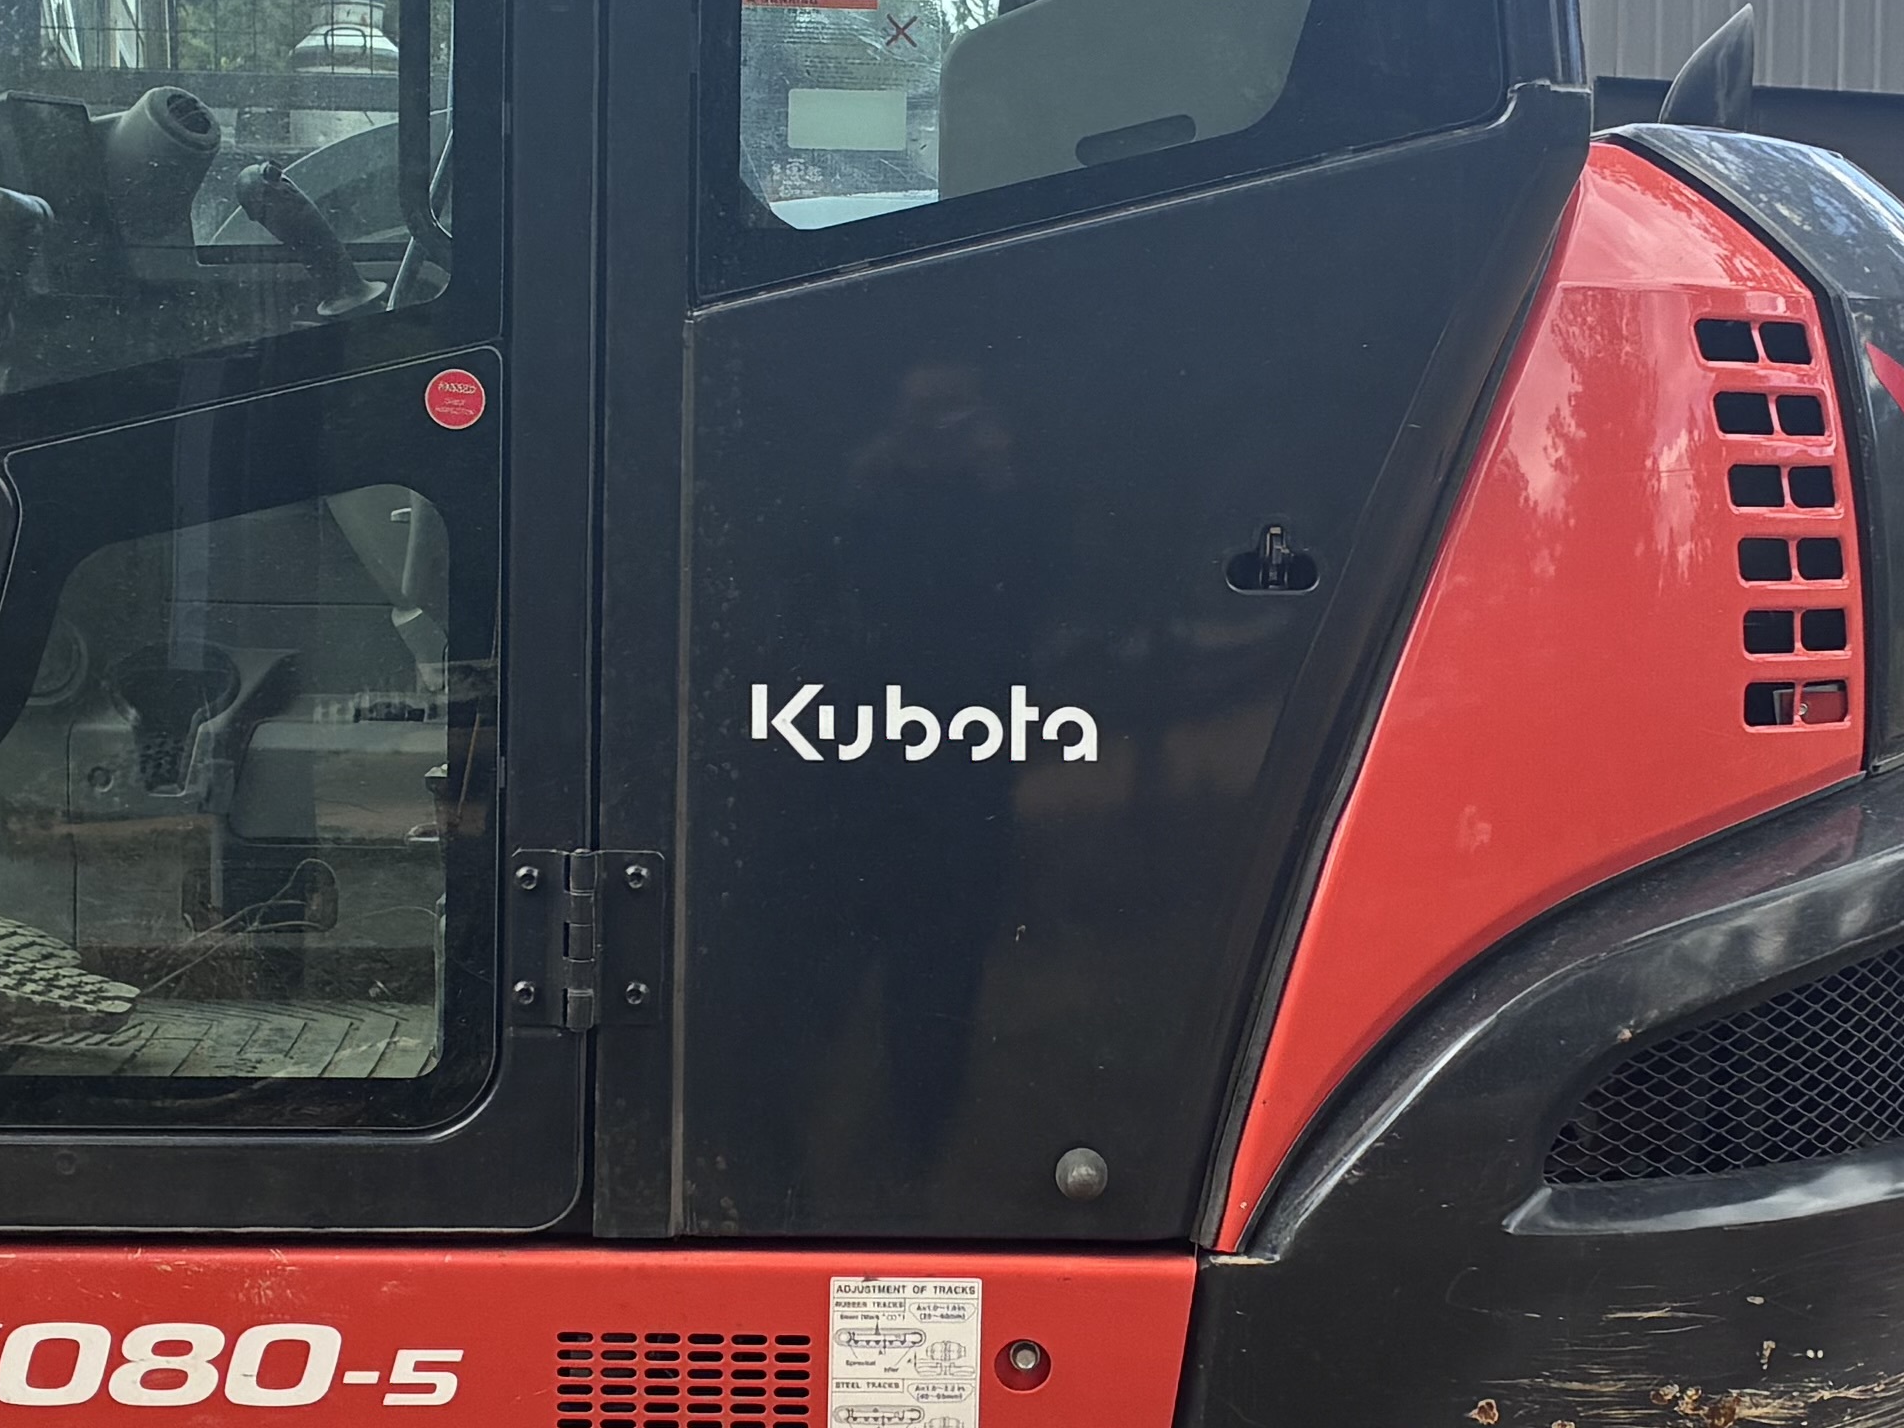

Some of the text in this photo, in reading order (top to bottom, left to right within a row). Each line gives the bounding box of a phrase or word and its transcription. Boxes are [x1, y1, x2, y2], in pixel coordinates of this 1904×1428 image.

[751, 683, 1098, 762] Kubota
[836, 1284, 976, 1295] ADJUSTMENT OF TRACKS
